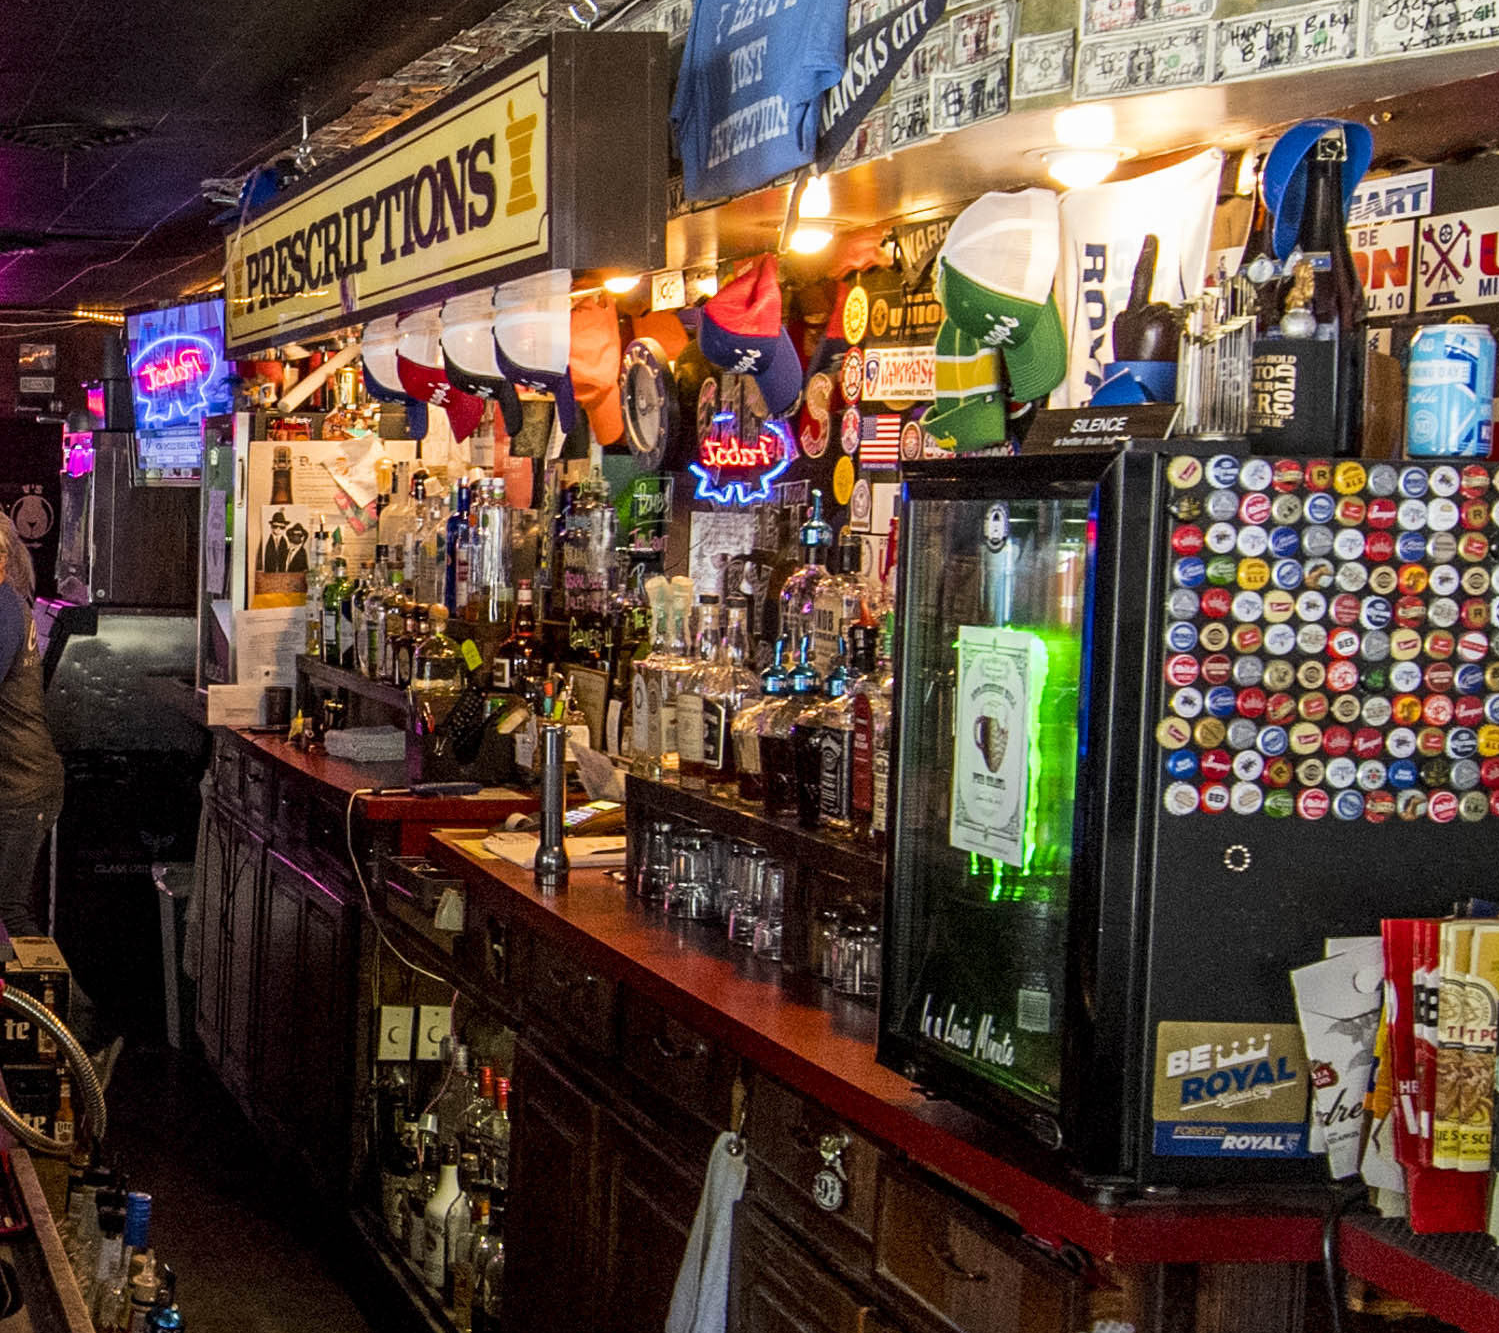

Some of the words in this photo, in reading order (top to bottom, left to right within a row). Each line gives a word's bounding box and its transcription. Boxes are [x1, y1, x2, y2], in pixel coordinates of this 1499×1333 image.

[820, 27, 888, 138] ANSAS
[245, 132, 498, 317] PRESCRIPTIONS
[1272, 364, 1297, 415] COLD
[1070, 416, 1129, 435] SILENCE
[1167, 1043, 1212, 1078] BE
[1181, 1056, 1297, 1106] ROYAL
[1221, 1134, 1286, 1152] ROYAL
